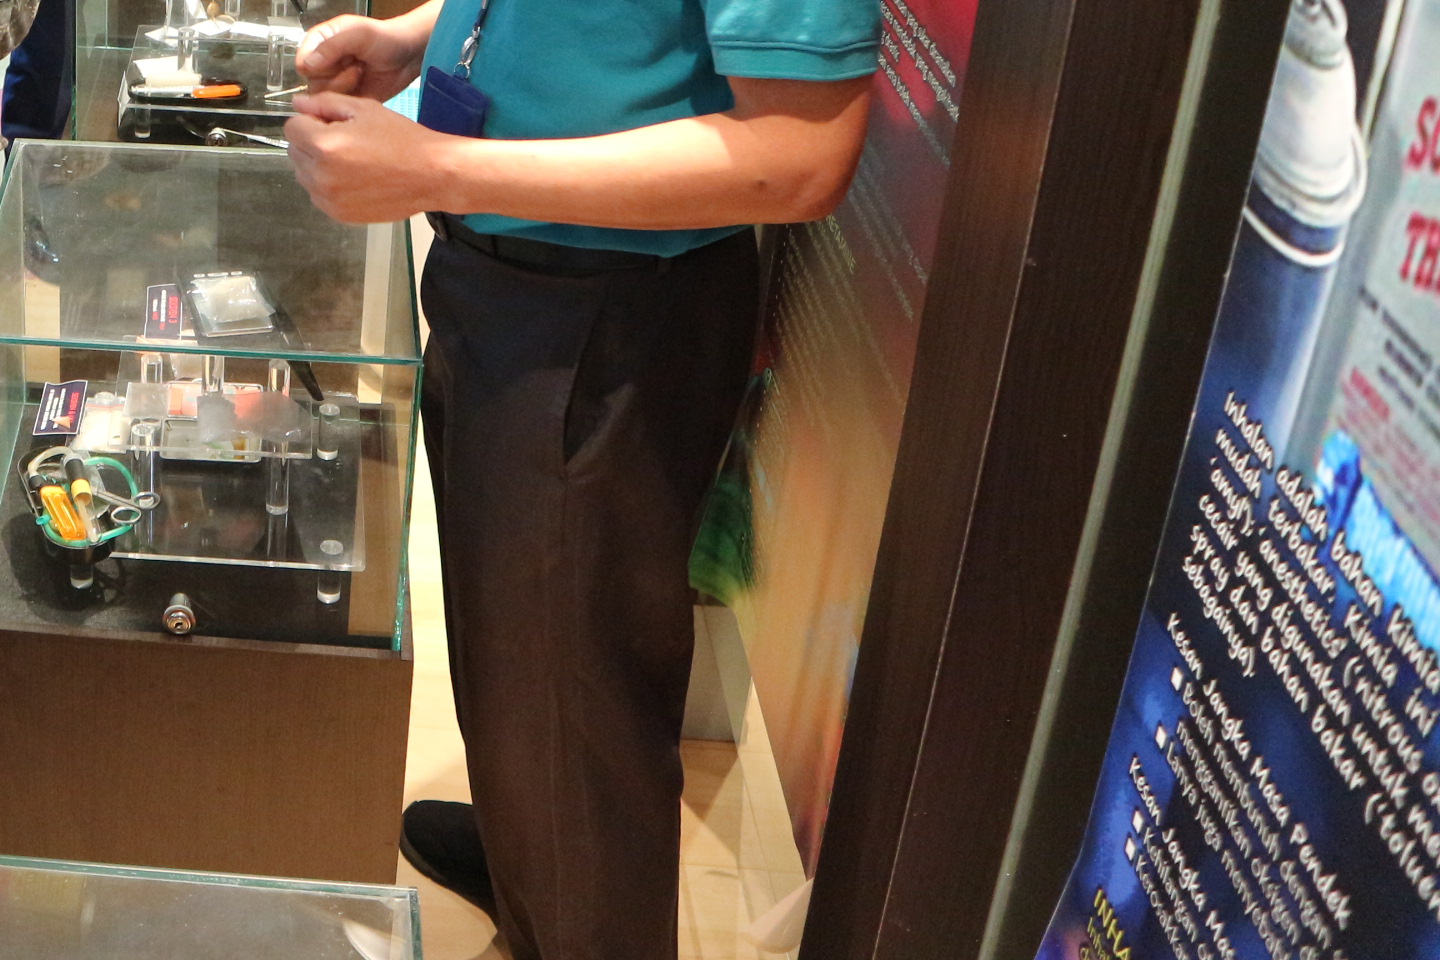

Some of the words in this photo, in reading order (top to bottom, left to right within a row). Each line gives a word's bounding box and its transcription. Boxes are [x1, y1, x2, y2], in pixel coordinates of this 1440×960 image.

[1190, 523, 1230, 593] spray
[1229, 585, 1259, 635] dan
[1261, 625, 1309, 713] bahan
[1312, 703, 1367, 790] bakar
[1215, 428, 1261, 500] mudah
[1405, 687, 1439, 738] ini
[1224, 391, 1274, 470] Inhalan
[1276, 468, 1328, 542] adalah
[1330, 530, 1384, 617] bahan
[1387, 606, 1440, 696] kimia
[1167, 611, 1204, 681] Kesan
[1203, 678, 1252, 761] Jangka
[1250, 756, 1291, 829] Masa
[1290, 822, 1352, 931] Pendek
[1198, 494, 1239, 551] cecair
[1234, 551, 1273, 612] yang
[1271, 602, 1352, 727] digunakan
[1352, 722, 1409, 810] untuk
[1407, 803, 1440, 869] me
[1129, 756, 1161, 827] Kesan
[1162, 826, 1207, 913] Jangka
[1143, 826, 1200, 943] Kehilangan
[1182, 682, 1214, 745] Boleh
[1213, 742, 1281, 862] membunuh
[1280, 860, 1333, 950] dengan
[1194, 798, 1223, 852] juga
